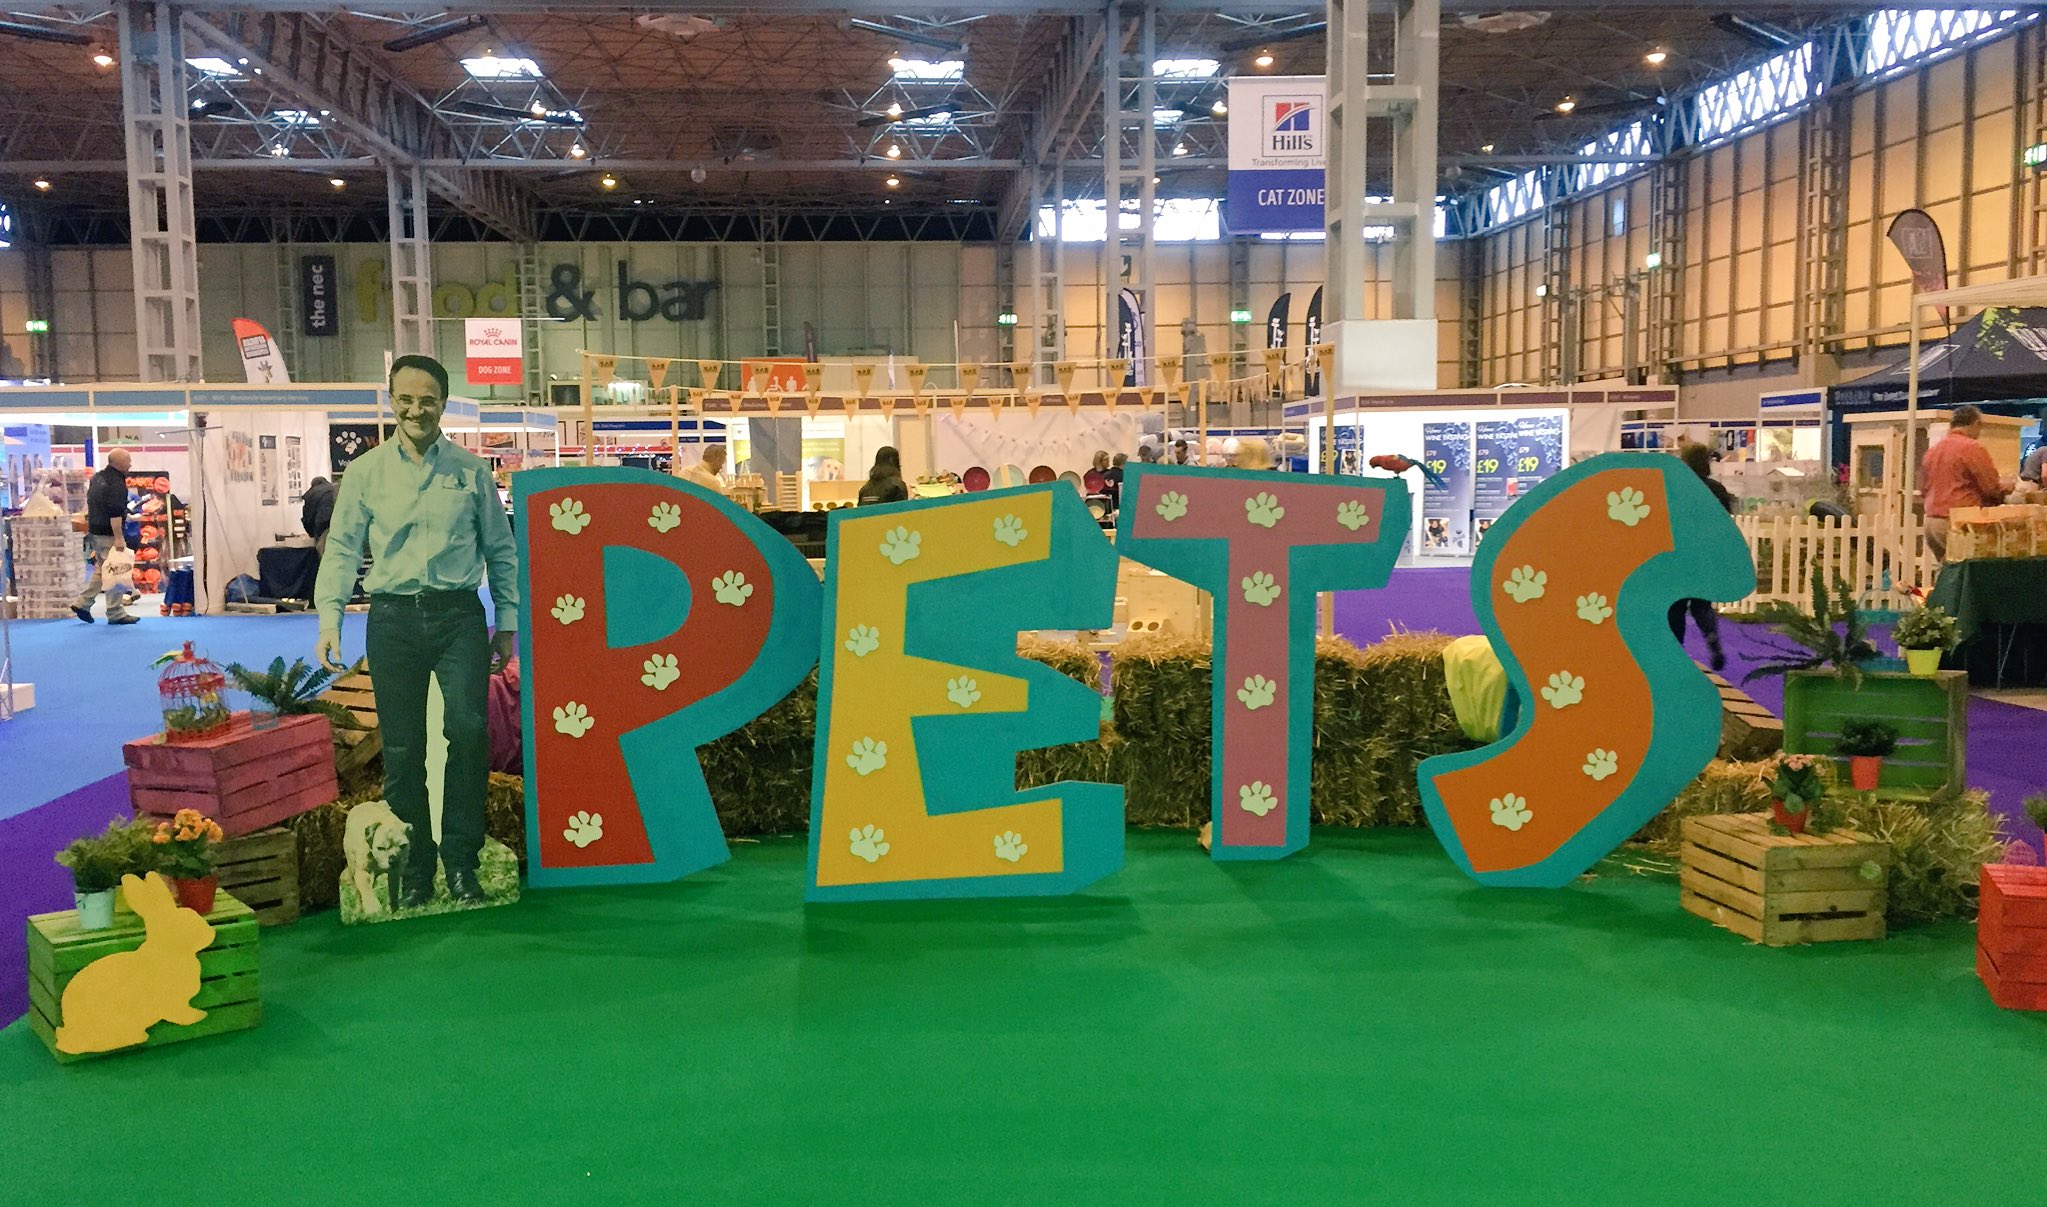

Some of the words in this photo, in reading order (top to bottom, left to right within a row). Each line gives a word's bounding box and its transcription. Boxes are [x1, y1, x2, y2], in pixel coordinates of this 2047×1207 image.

[1272, 134, 1313, 150] Hill's
[1252, 158, 1309, 168] Transforming
[1258, 189, 1284, 206] CAT
[1287, 188, 1325, 205] ZONE
[311, 264, 325, 296] nec
[354, 259, 518, 321] fod
[546, 263, 599, 322] &
[618, 259, 720, 322] bar
[311, 298, 326, 328] the
[469, 338, 492, 346] ROYAL
[493, 338, 518, 346] CANIN
[478, 365, 493, 374] DOG
[494, 365, 512, 374] ZONE
[1476, 458, 1499, 474] £19
[1518, 456, 1539, 473] £19
[512, 452, 1757, 905] PETS
